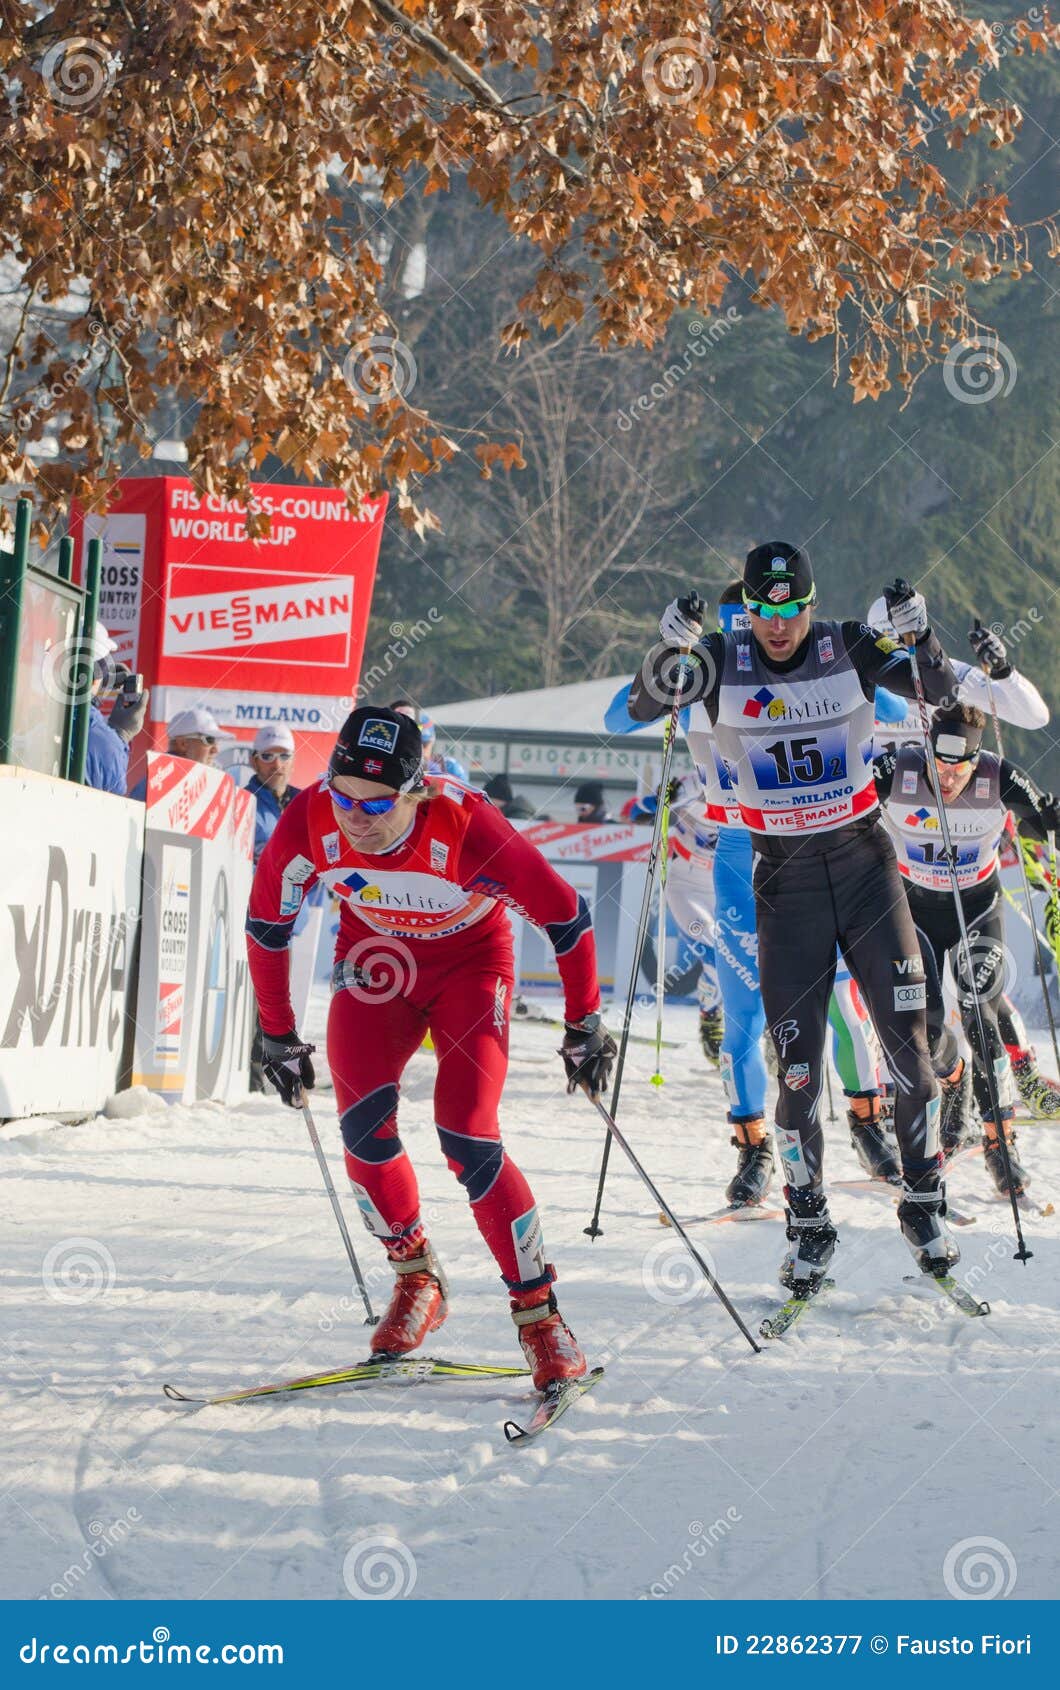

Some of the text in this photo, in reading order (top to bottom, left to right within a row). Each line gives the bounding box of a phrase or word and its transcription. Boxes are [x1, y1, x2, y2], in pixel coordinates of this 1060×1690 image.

[171, 489, 200, 510] FIS
[169, 518, 248, 542] WORLD
[170, 594, 350, 641] VIESSMANN
[236, 704, 321, 724] MILANO
[767, 699, 843, 722] CityLife
[361, 735, 393, 750] AKER
[765, 737, 825, 785] 15
[829, 757, 844, 778] 2
[792, 785, 854, 806] MILANO
[769, 804, 848, 829] VIESSMANN
[162, 910, 188, 934] CROSS
[1, 844, 127, 1053] xDrive
[893, 959, 924, 976] VIS
[962, 944, 1004, 1009] RAFFEISEN
